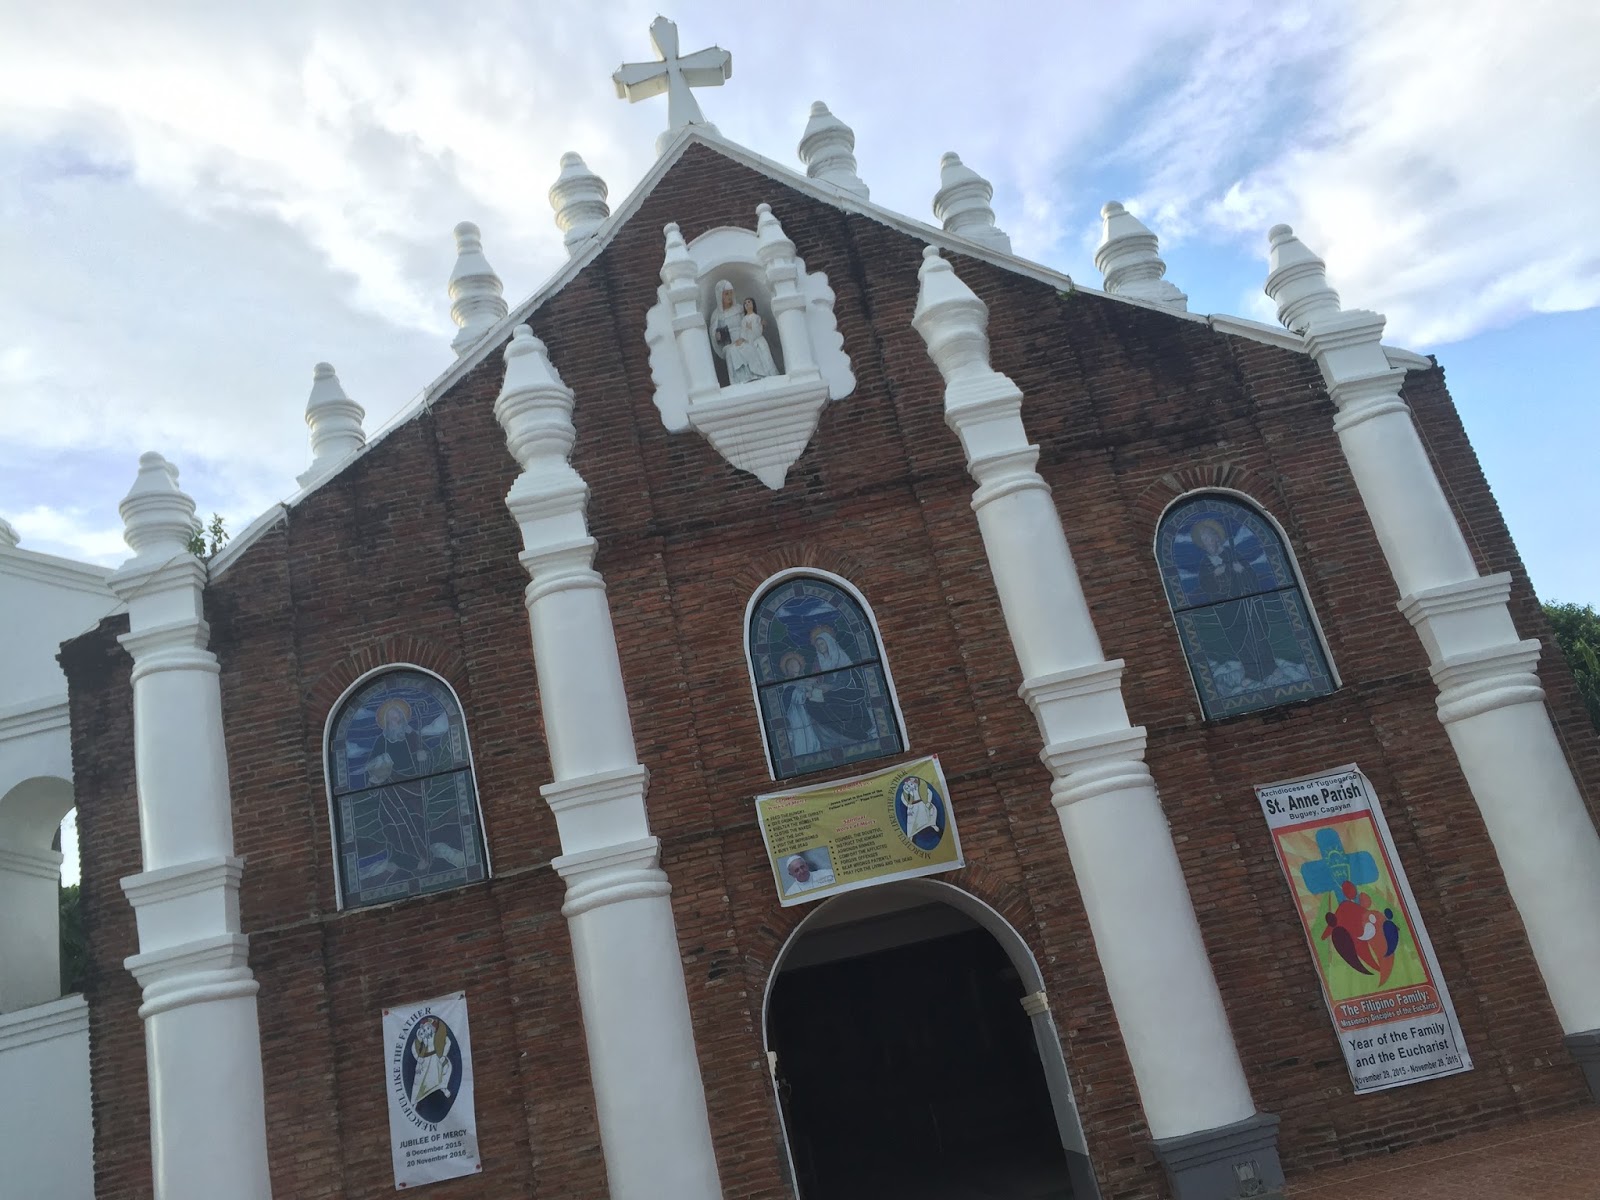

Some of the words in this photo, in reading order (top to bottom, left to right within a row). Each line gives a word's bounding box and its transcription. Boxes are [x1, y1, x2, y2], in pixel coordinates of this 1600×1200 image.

[888, 770, 908, 794] FATHER
[1261, 785, 1305, 798] Archdiocese
[1315, 774, 1357, 787] Tuguegarao
[1266, 799, 1285, 815] St.
[1288, 795, 1319, 810] Anne
[1321, 783, 1361, 804] Parish
[1289, 810, 1319, 820] Buguey,
[1321, 803, 1351, 813] Cagayan
[1340, 1004, 1359, 1016] The
[1361, 999, 1395, 1013] Filipino
[1396, 991, 1430, 1006] Family:
[1341, 1016, 1370, 1027] Missionary
[1371, 1010, 1395, 1022] Disciples
[1412, 1002, 1437, 1012] Eucharist
[398, 1007, 431, 1040] FATHER
[1349, 1039, 1373, 1051] Year
[1377, 1034, 1388, 1046] of
[1390, 1030, 1408, 1042] the
[1410, 1023, 1445, 1039] Family
[394, 1042, 403, 1064] THE
[1356, 1055, 1375, 1068] and
[1378, 1051, 1395, 1063] the
[1399, 1039, 1449, 1058] Eucharist
[394, 1067, 402, 1092] LIKE
[1392, 1066, 1406, 1077] 2015
[1410, 1061, 1437, 1073] November
[399, 1094, 438, 1132] MERCIFUL
[399, 1136, 429, 1149] JUBILEE
[431, 1134, 441, 1142] OF
[443, 1129, 467, 1139] MERCY
[412, 1144, 444, 1156] December
[445, 1141, 462, 1149] 2015
[417, 1154, 448, 1165] November
[450, 1150, 466, 1158] 2016
